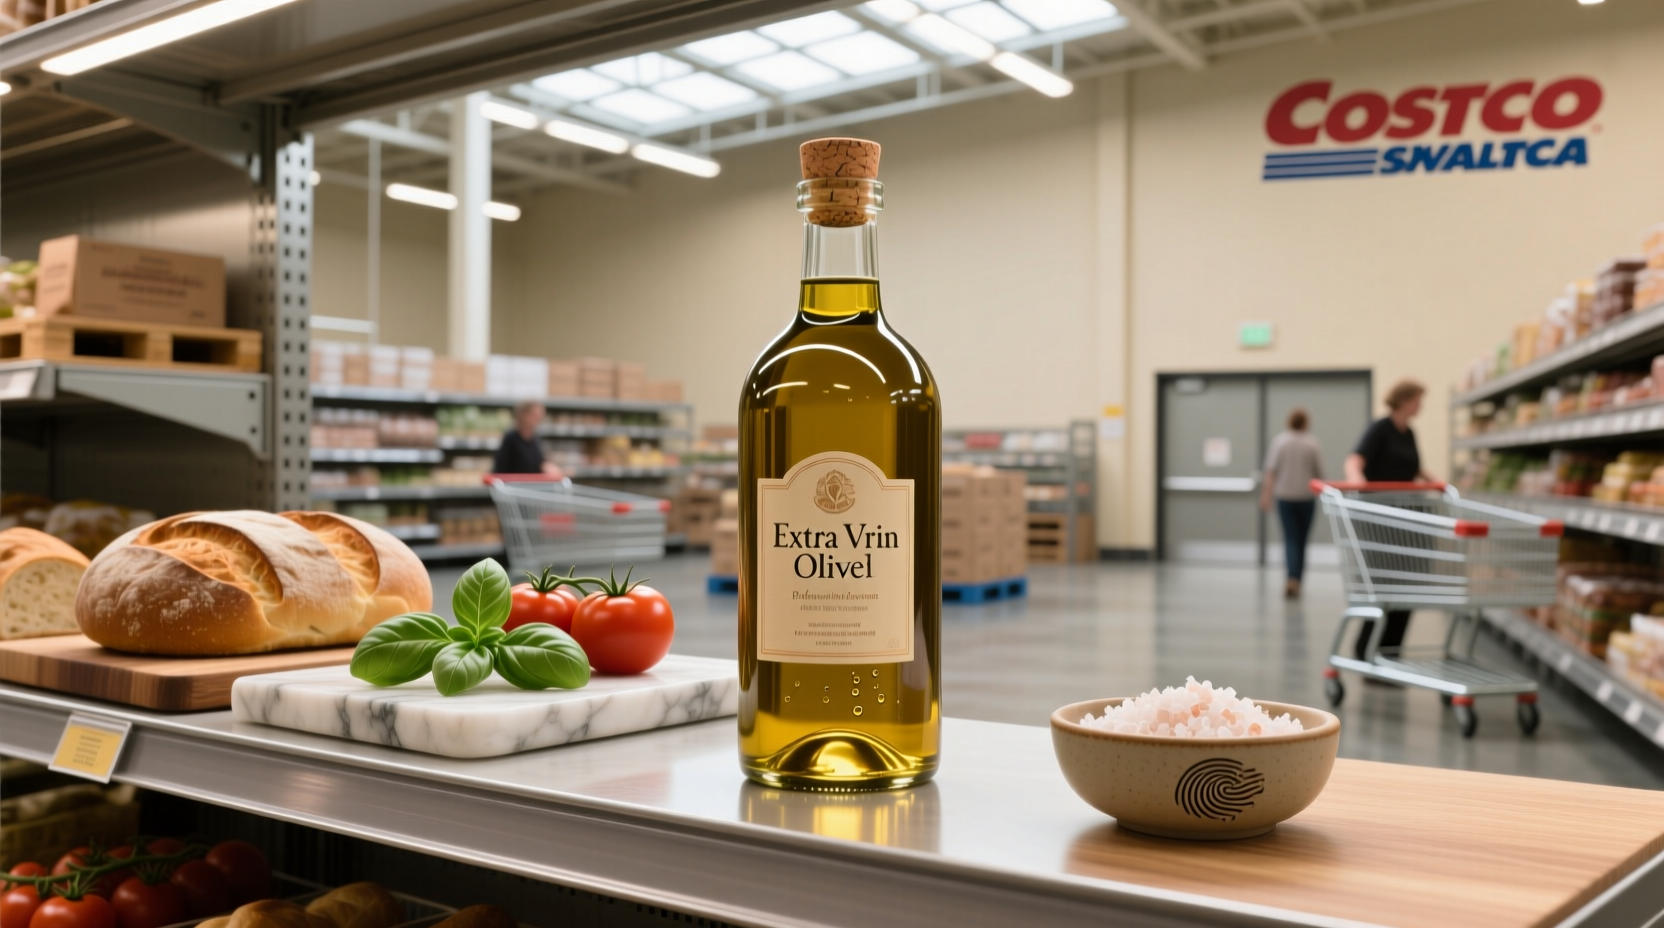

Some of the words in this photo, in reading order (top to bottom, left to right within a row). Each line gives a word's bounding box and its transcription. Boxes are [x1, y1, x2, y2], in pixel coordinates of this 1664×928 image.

[1264, 76, 1603, 146] COSTCO
[773, 522, 838, 549] Extra
[843, 523, 899, 549] Vrin
[794, 552, 874, 579] Olivel
